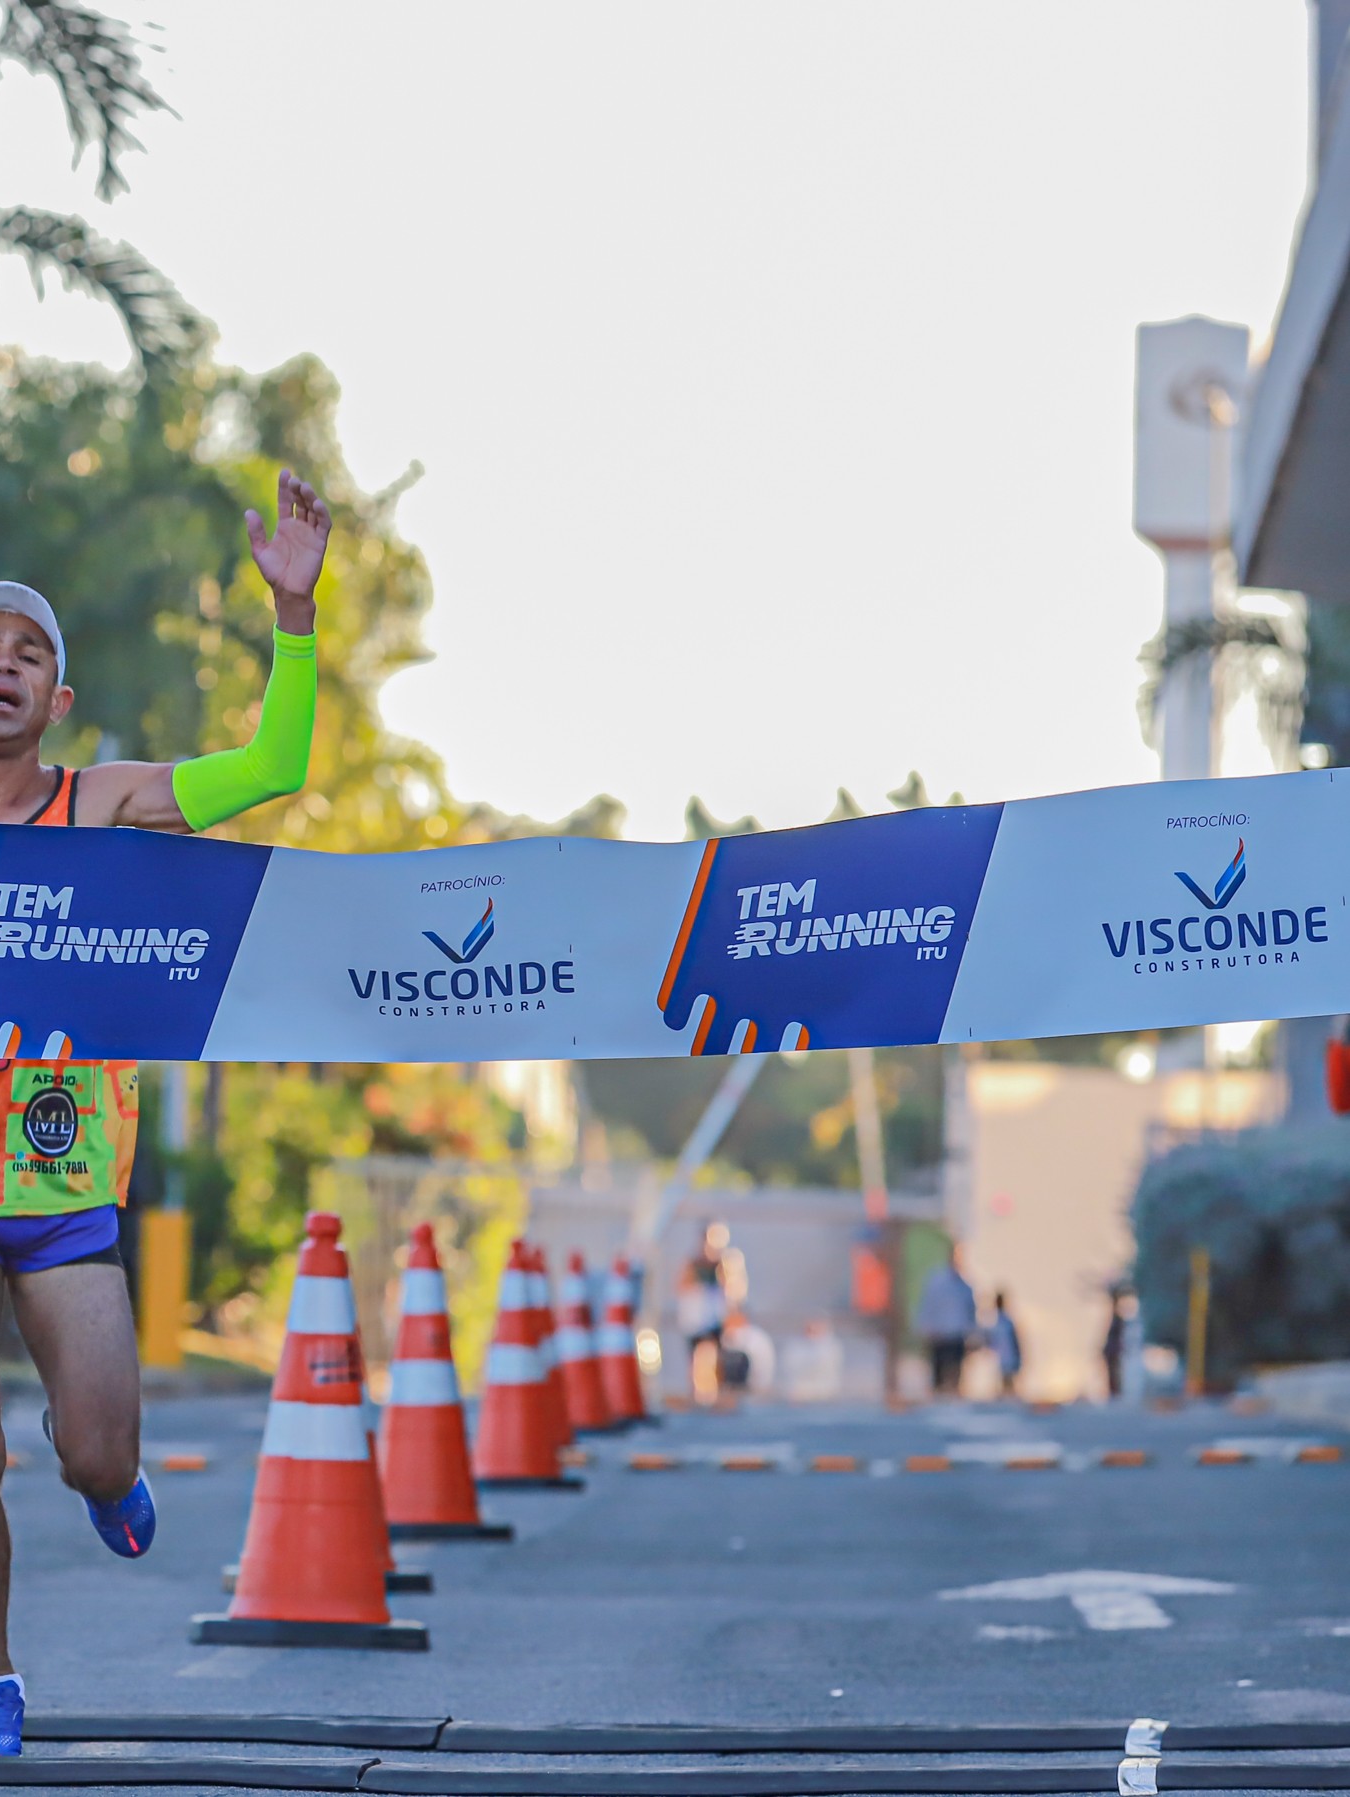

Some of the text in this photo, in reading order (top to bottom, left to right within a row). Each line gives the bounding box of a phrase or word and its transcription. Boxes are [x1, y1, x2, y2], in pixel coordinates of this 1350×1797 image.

[1166, 812, 1251, 829] PATROCÍNIO:
[420, 874, 506, 893] PATROCÍNIO:
[736, 878, 817, 920] TEM
[726, 905, 956, 960] RUNNING
[1101, 906, 1329, 958] VISCONDE
[916, 946, 948, 961] ITU
[1134, 951, 1300, 974] CONSTRUTORA
[168, 967, 200, 981] ITU
[347, 960, 575, 1002] VISCONDE
[379, 999, 546, 1017] CONSTRUTORA
